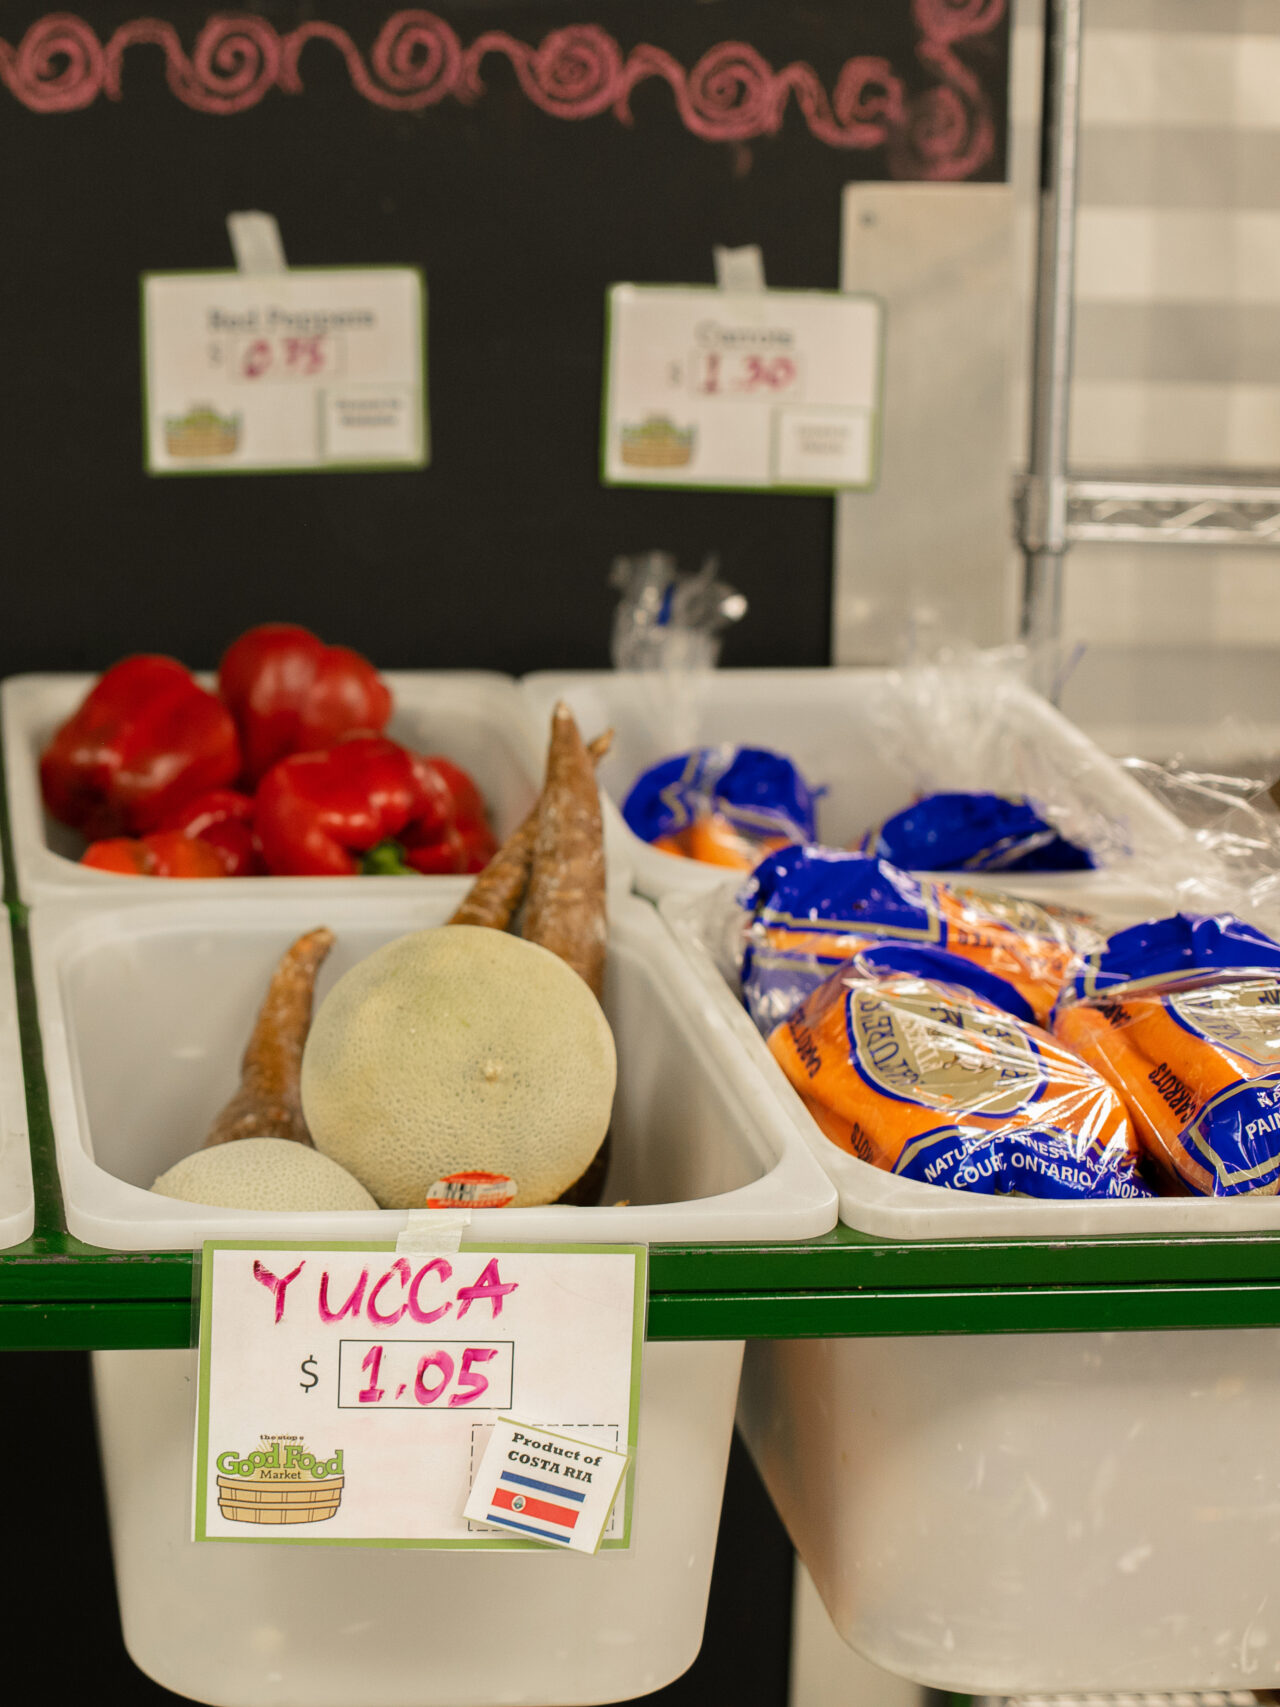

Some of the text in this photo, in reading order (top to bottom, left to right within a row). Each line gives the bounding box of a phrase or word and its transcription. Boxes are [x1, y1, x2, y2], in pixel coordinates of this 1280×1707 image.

[1148, 1062, 1197, 1124] CARROTS
[253, 1257, 519, 1328] YUCCA
[300, 1345, 499, 1409] $ 1.05
[216, 1443, 345, 1480] Good Food
[507, 1450, 593, 1483] COSTA RIA
[511, 1432, 603, 1467] Product of
[260, 1469, 302, 1480] Market
